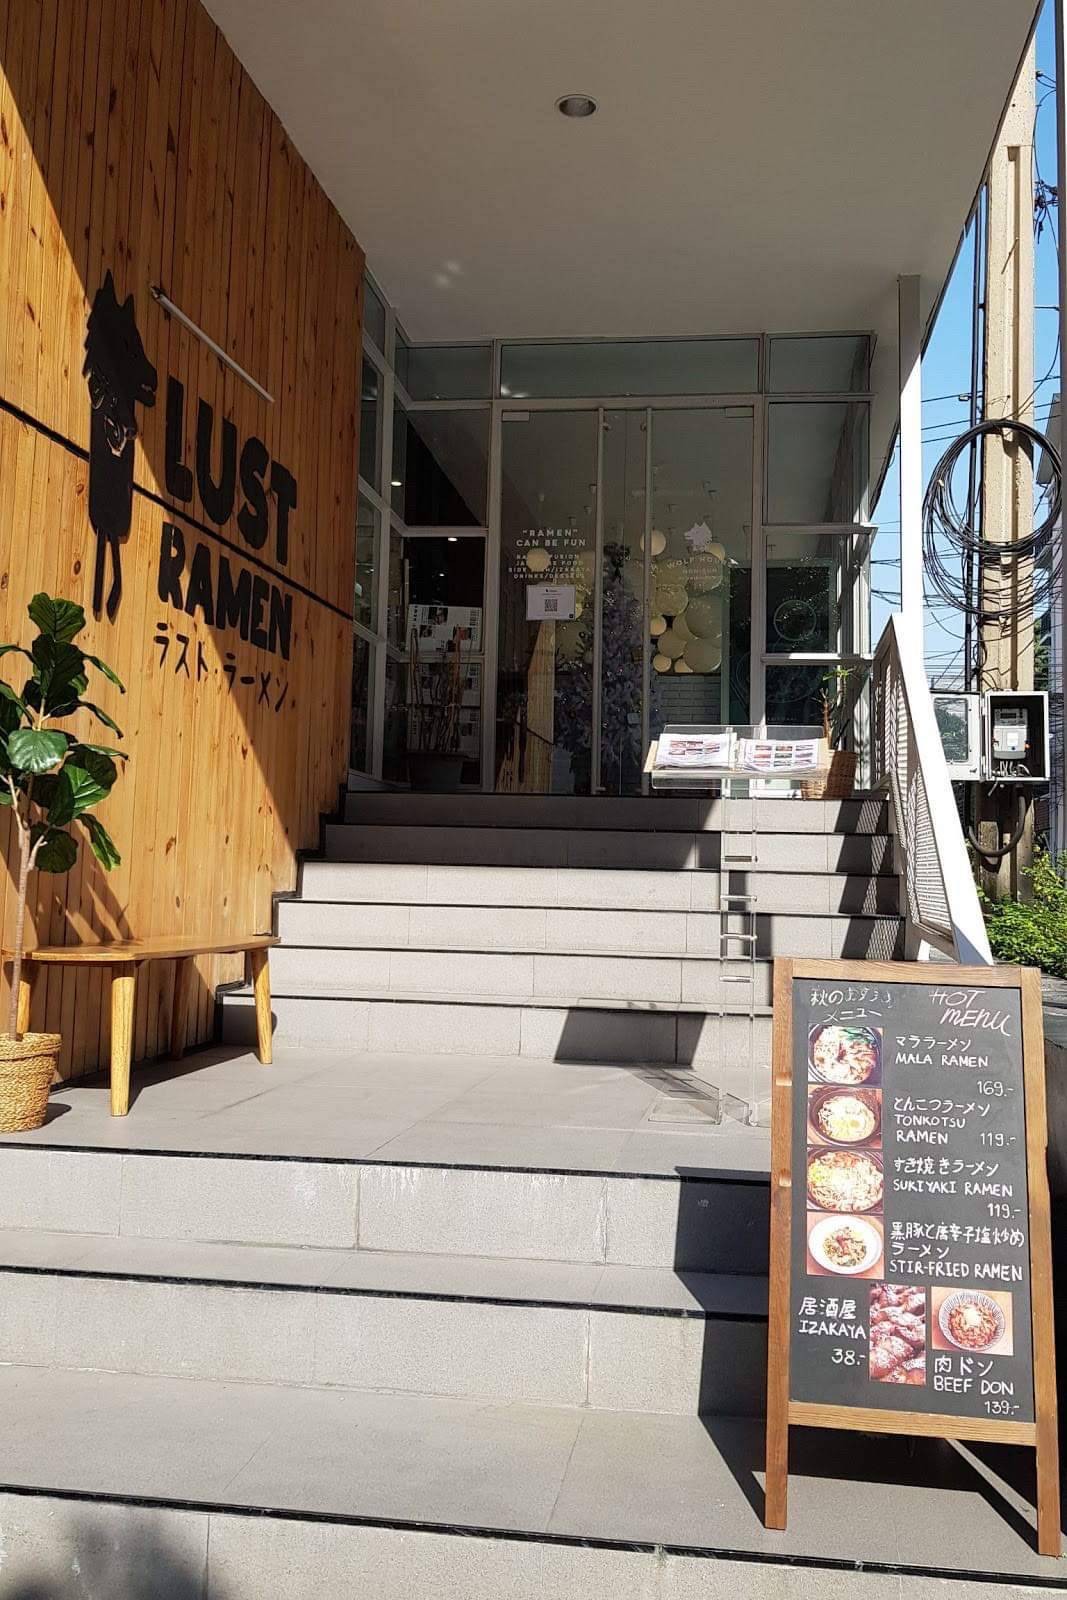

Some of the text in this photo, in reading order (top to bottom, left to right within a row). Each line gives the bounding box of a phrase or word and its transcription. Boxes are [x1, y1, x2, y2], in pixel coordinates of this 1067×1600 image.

[165, 374, 297, 566] LUST
[516, 538, 586, 547] CAN BE FUN
[157, 521, 293, 661] RAMEN
[929, 989, 985, 1006] HOT
[823, 1008, 883, 1023] メニュー
[896, 1036, 972, 1052] マララーメン
[895, 1052, 989, 1068] MALA RAMEN
[893, 1096, 992, 1117] とんこつラーメン
[893, 1114, 966, 1129] TONKOTSU
[896, 1129, 949, 1145] RAMEN
[893, 1177, 1014, 1197] SUKIYAKI RAMEN
[891, 1242, 950, 1259] ラーメン
[889, 1259, 1023, 1281] STIR-FRIED RAMEN
[798, 1296, 857, 1320] 居酒屋
[798, 1320, 867, 1340] IZAKAYA
[933, 1376, 1014, 1396] BEEF DON
